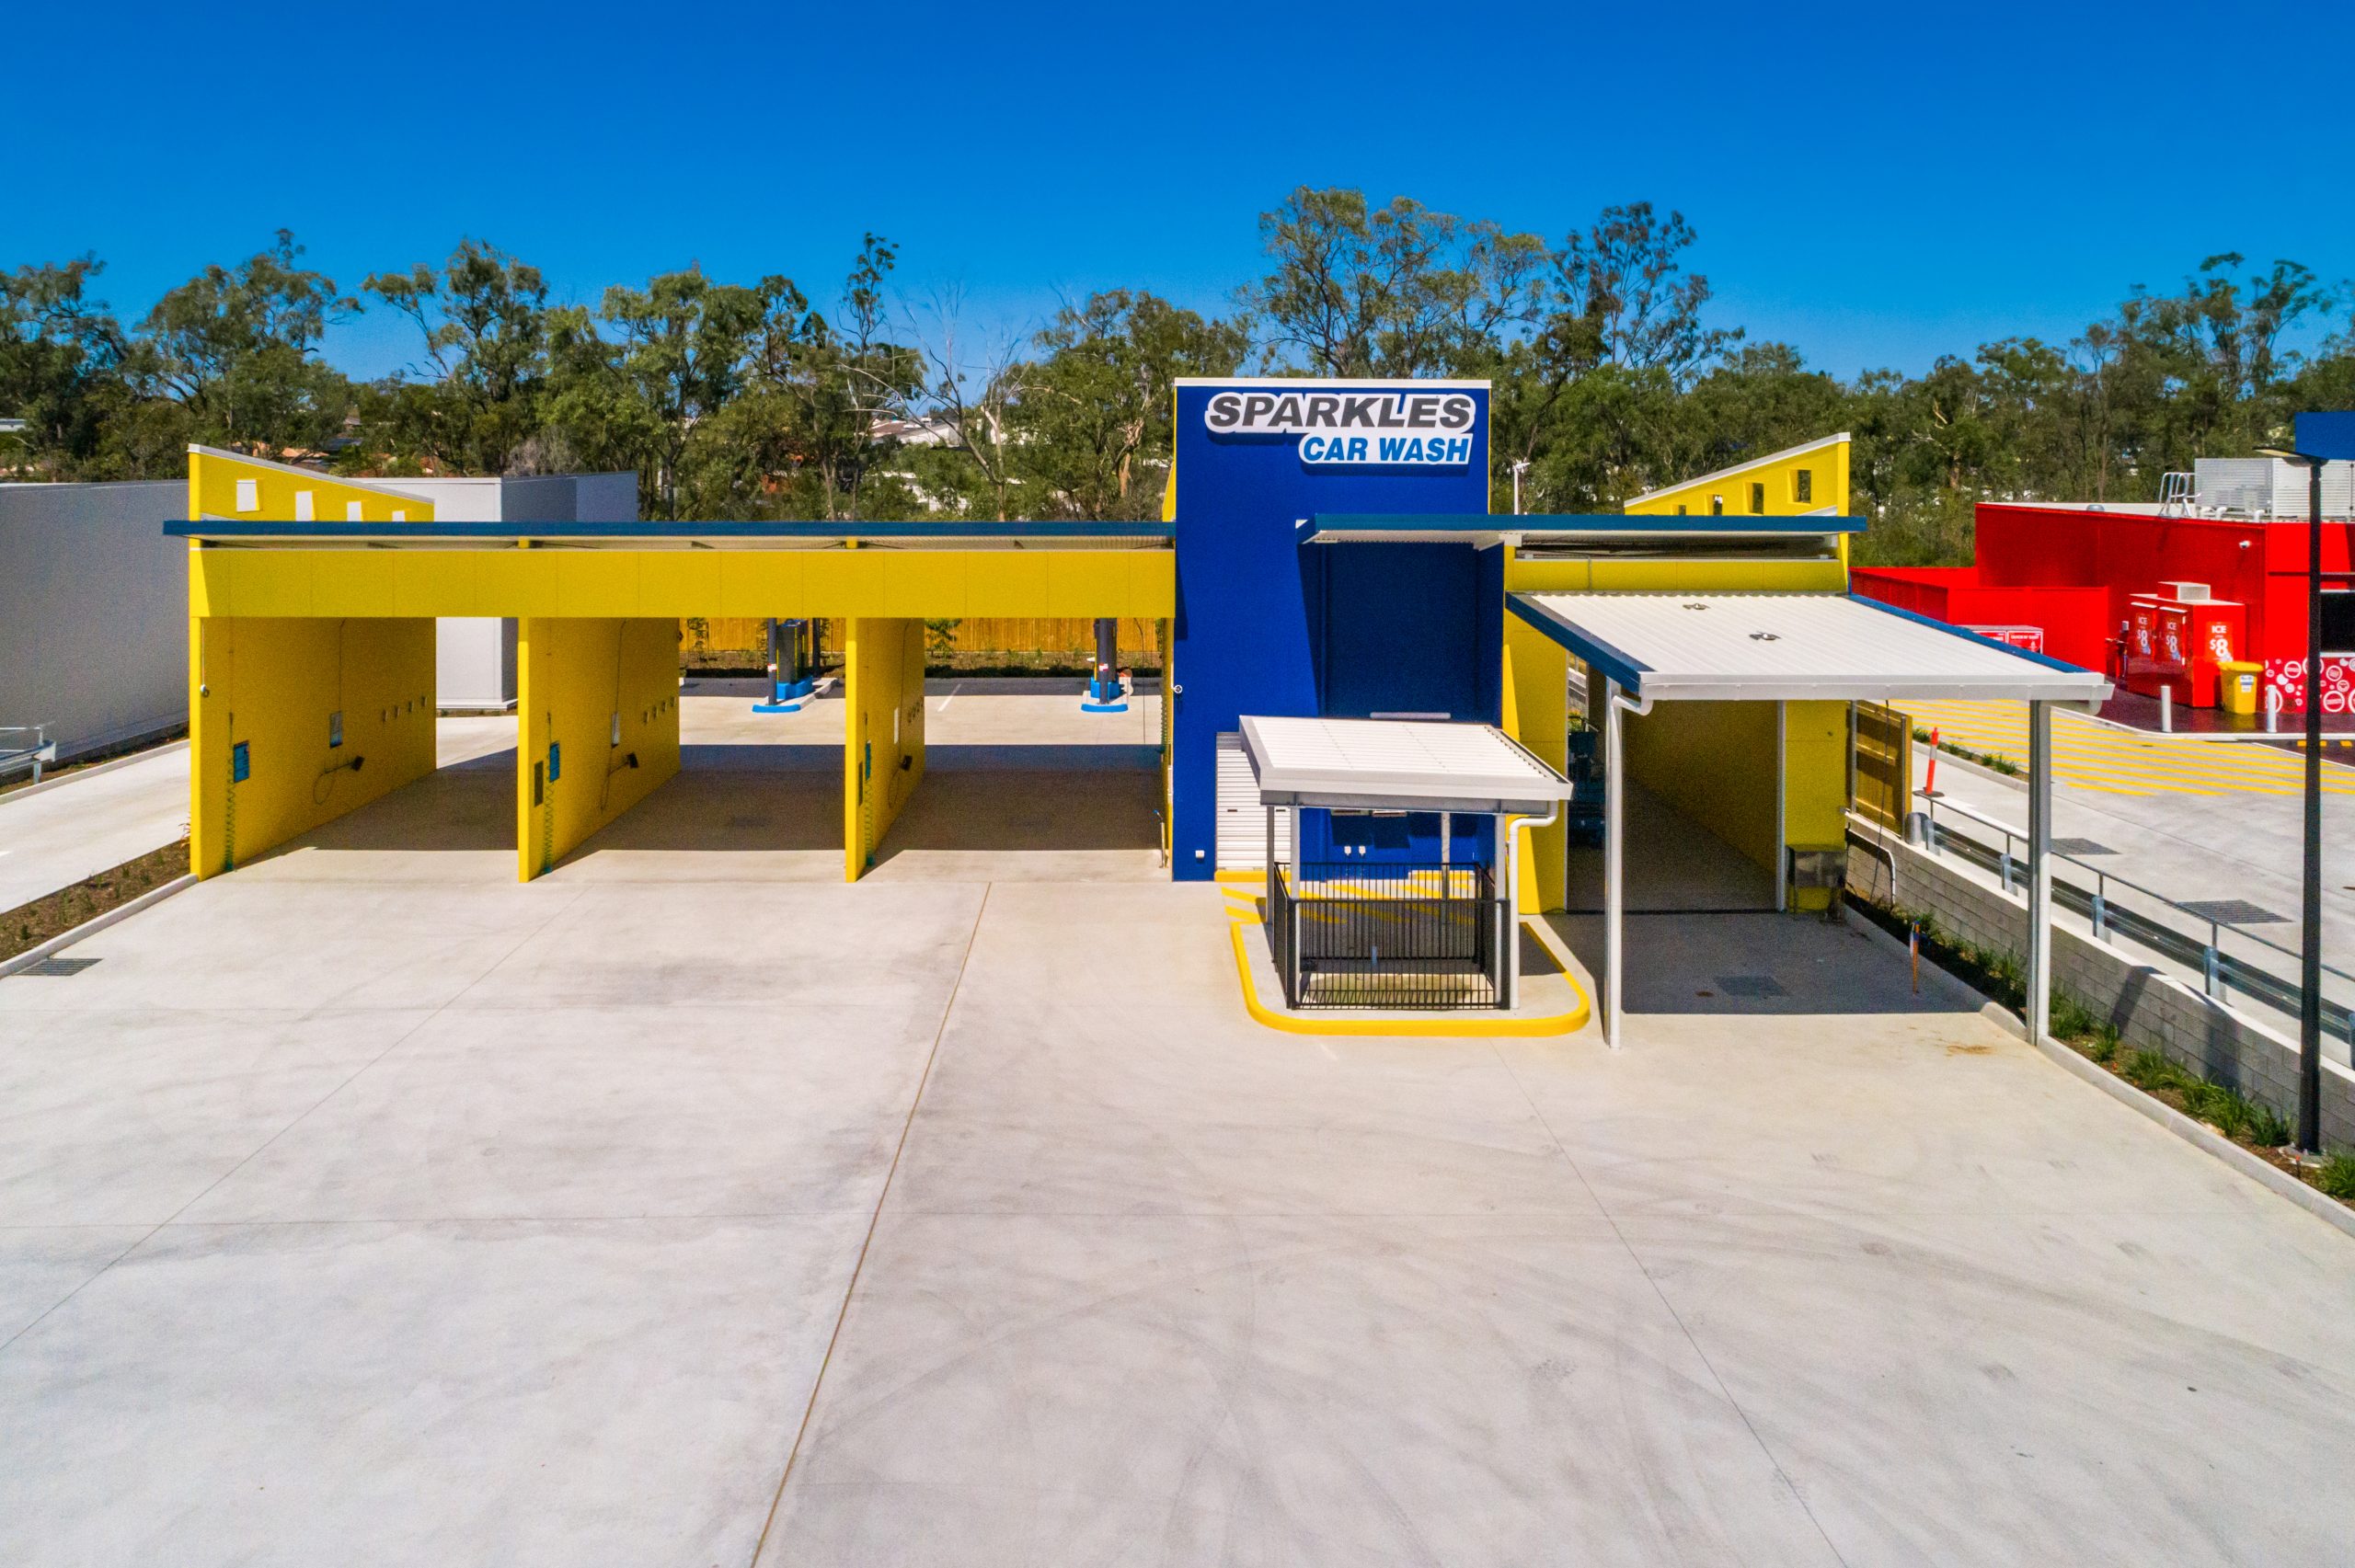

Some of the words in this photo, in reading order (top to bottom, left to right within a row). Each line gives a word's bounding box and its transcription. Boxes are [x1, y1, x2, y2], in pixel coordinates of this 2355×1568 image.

[1209, 395, 1472, 429] SPARKLES
[1303, 437, 1368, 462] CAR
[1381, 438, 1470, 463] WASH
[2211, 624, 2227, 635] ICE
[2209, 637, 2229, 658] $8
